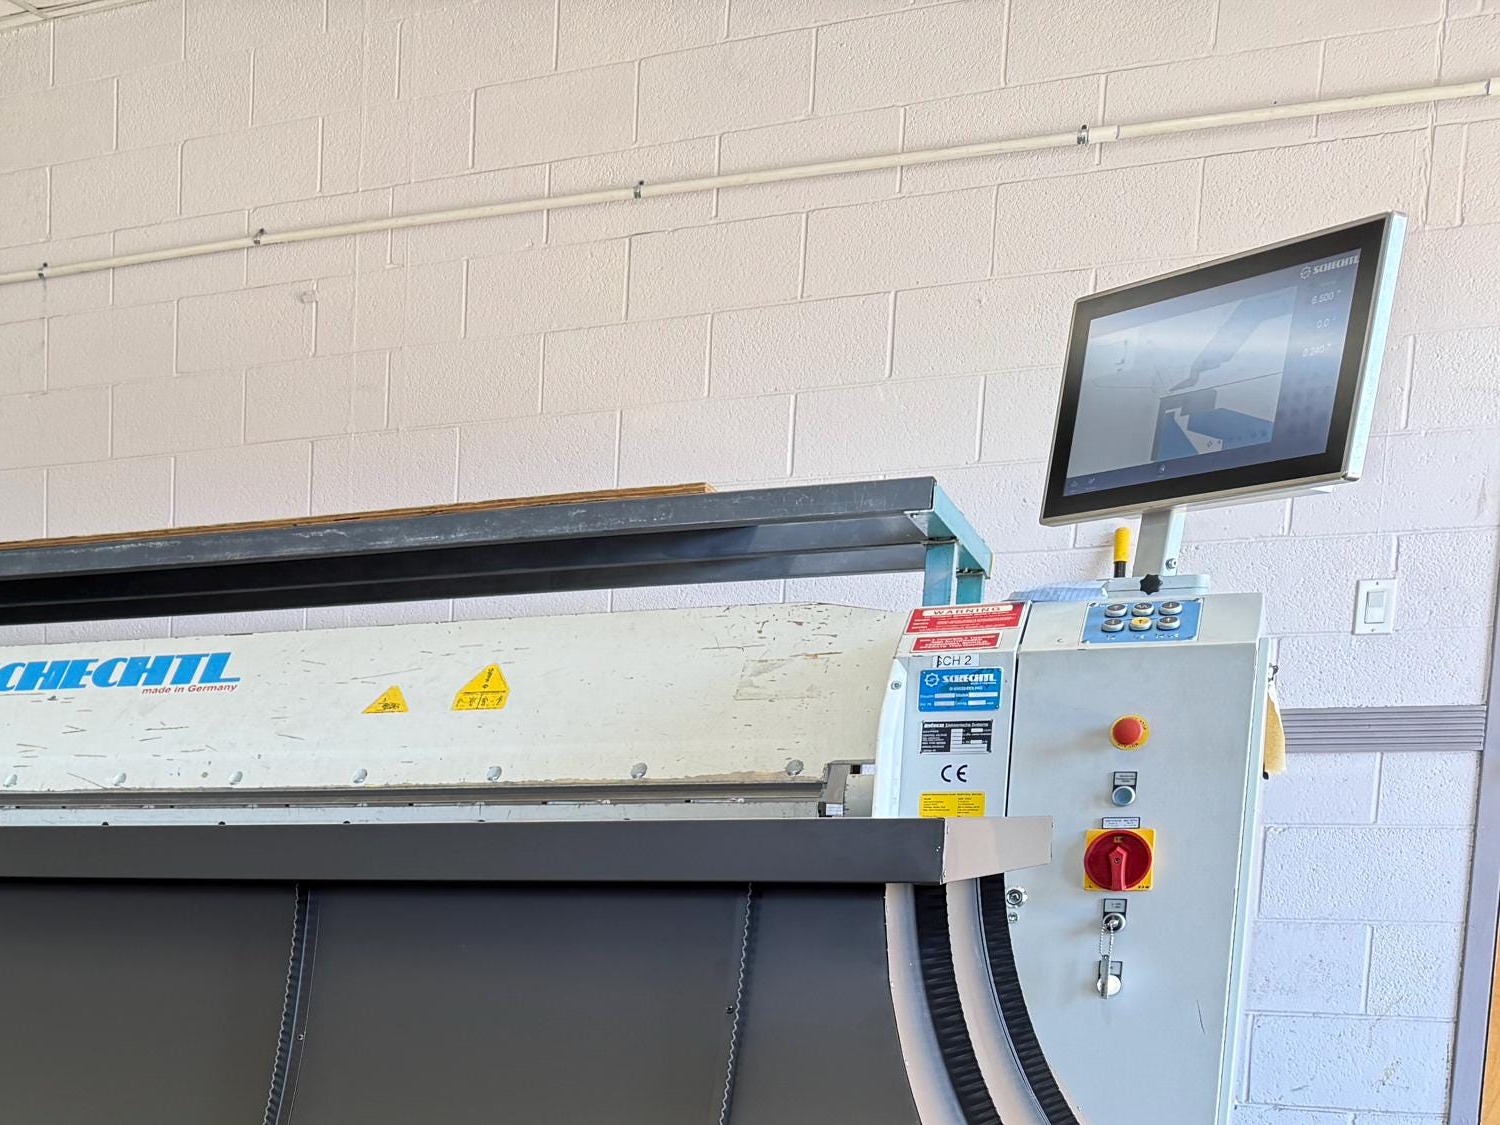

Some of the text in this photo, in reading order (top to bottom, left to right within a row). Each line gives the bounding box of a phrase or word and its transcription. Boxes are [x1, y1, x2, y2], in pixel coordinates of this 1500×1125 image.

[1312, 255, 1359, 275] SCHECHTL
[933, 606, 1001, 616] WARNING
[963, 654, 973, 666] 2
[941, 673, 997, 683] SCHECHTL
[141, 686, 172, 695] made
[188, 683, 238, 693] Germany
